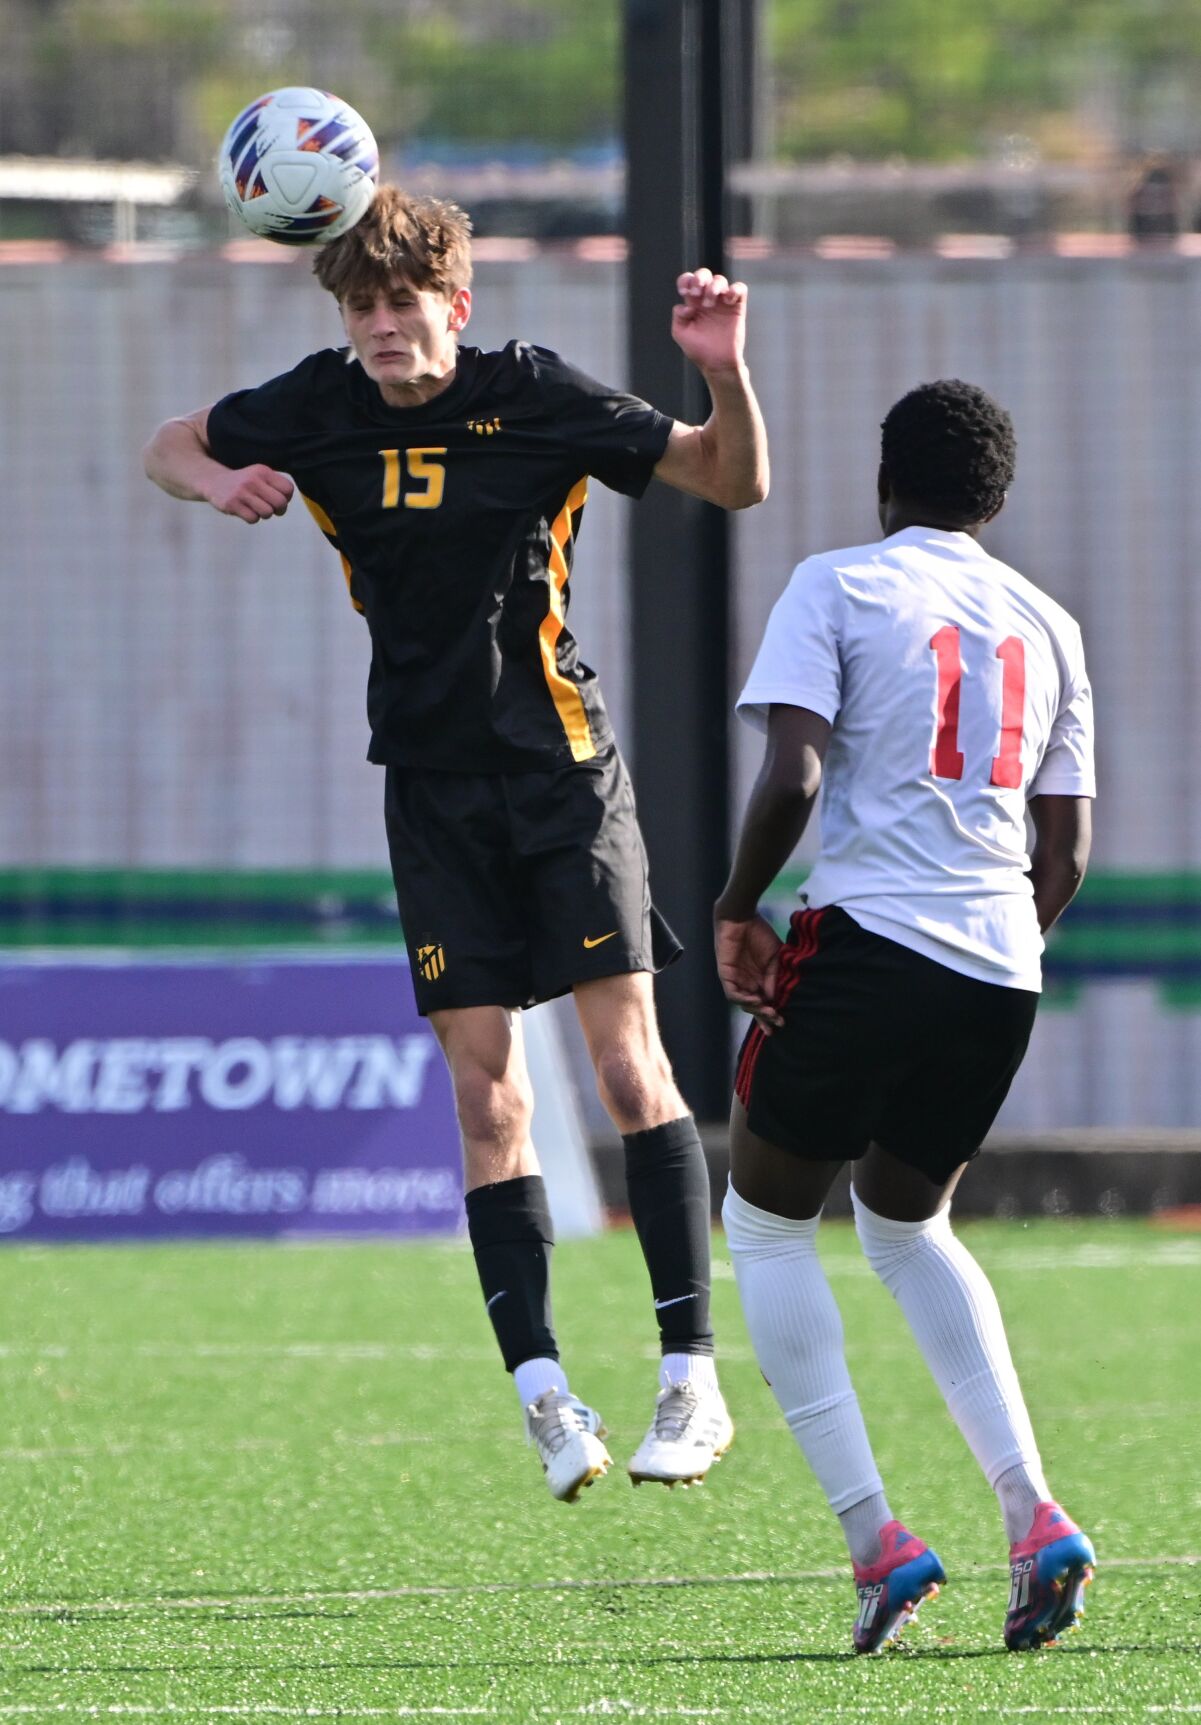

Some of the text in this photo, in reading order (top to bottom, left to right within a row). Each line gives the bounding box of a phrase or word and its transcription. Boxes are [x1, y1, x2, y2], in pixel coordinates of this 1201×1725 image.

[378, 447, 448, 510] 15
[928, 625, 1026, 790] 11
[0, 1034, 434, 1112] METOWN
[40, 1156, 150, 1216] that
[154, 1153, 308, 1214] offers
